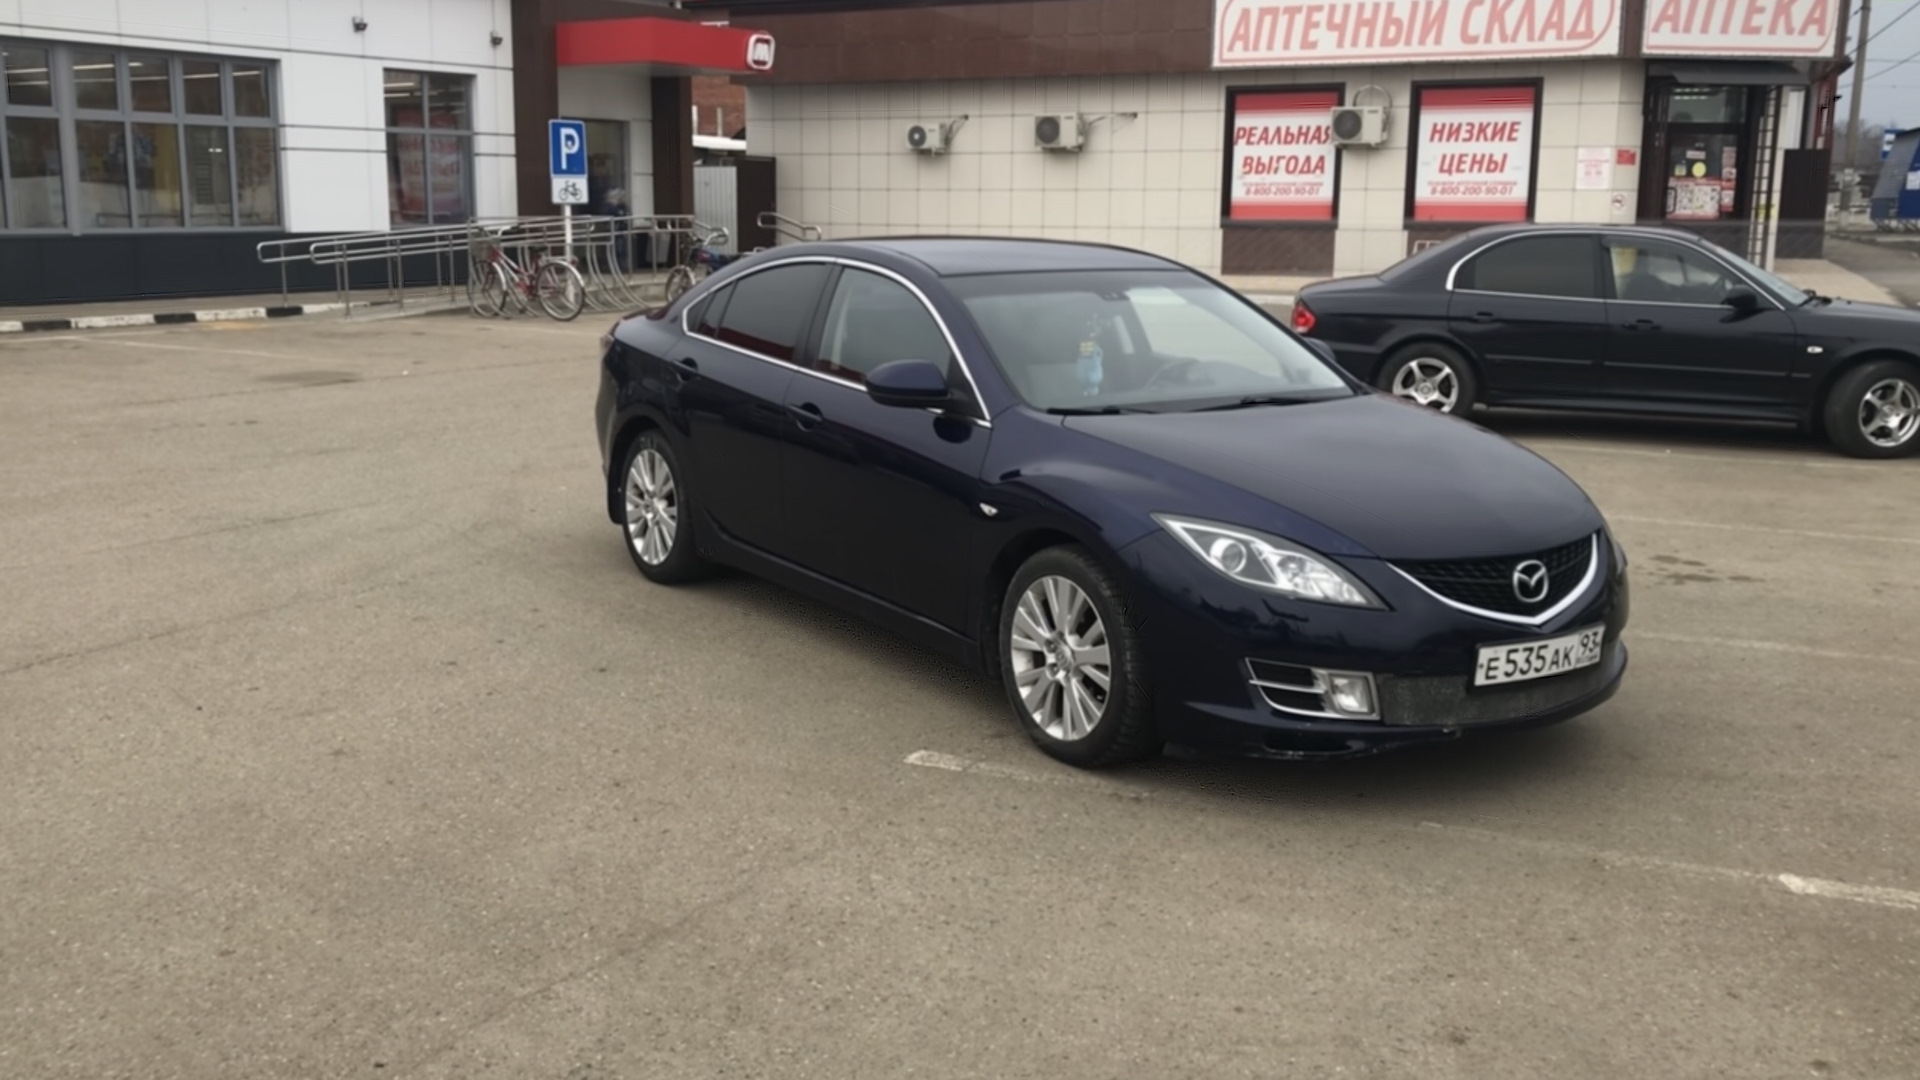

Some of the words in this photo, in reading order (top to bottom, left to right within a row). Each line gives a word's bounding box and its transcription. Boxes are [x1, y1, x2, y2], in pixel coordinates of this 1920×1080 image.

[1227, 0, 1449, 53] АПТЕЧНЫЙ
[1459, 0, 1595, 45] СКЛАД
[1651, 0, 1829, 37] АПТЕКА
[1233, 124, 1331, 147] РЕАЛЬНАЯ
[1429, 121, 1522, 143] НИЗКИЕ
[560, 127, 581, 170] P
[1242, 154, 1326, 176] ВЫГОДА
[1438, 152, 1508, 176] ЦЕНЫ
[1244, 186, 1321, 197] 8-800-200-90-01
[1429, 185, 1514, 196] 8-800-200-90-01
